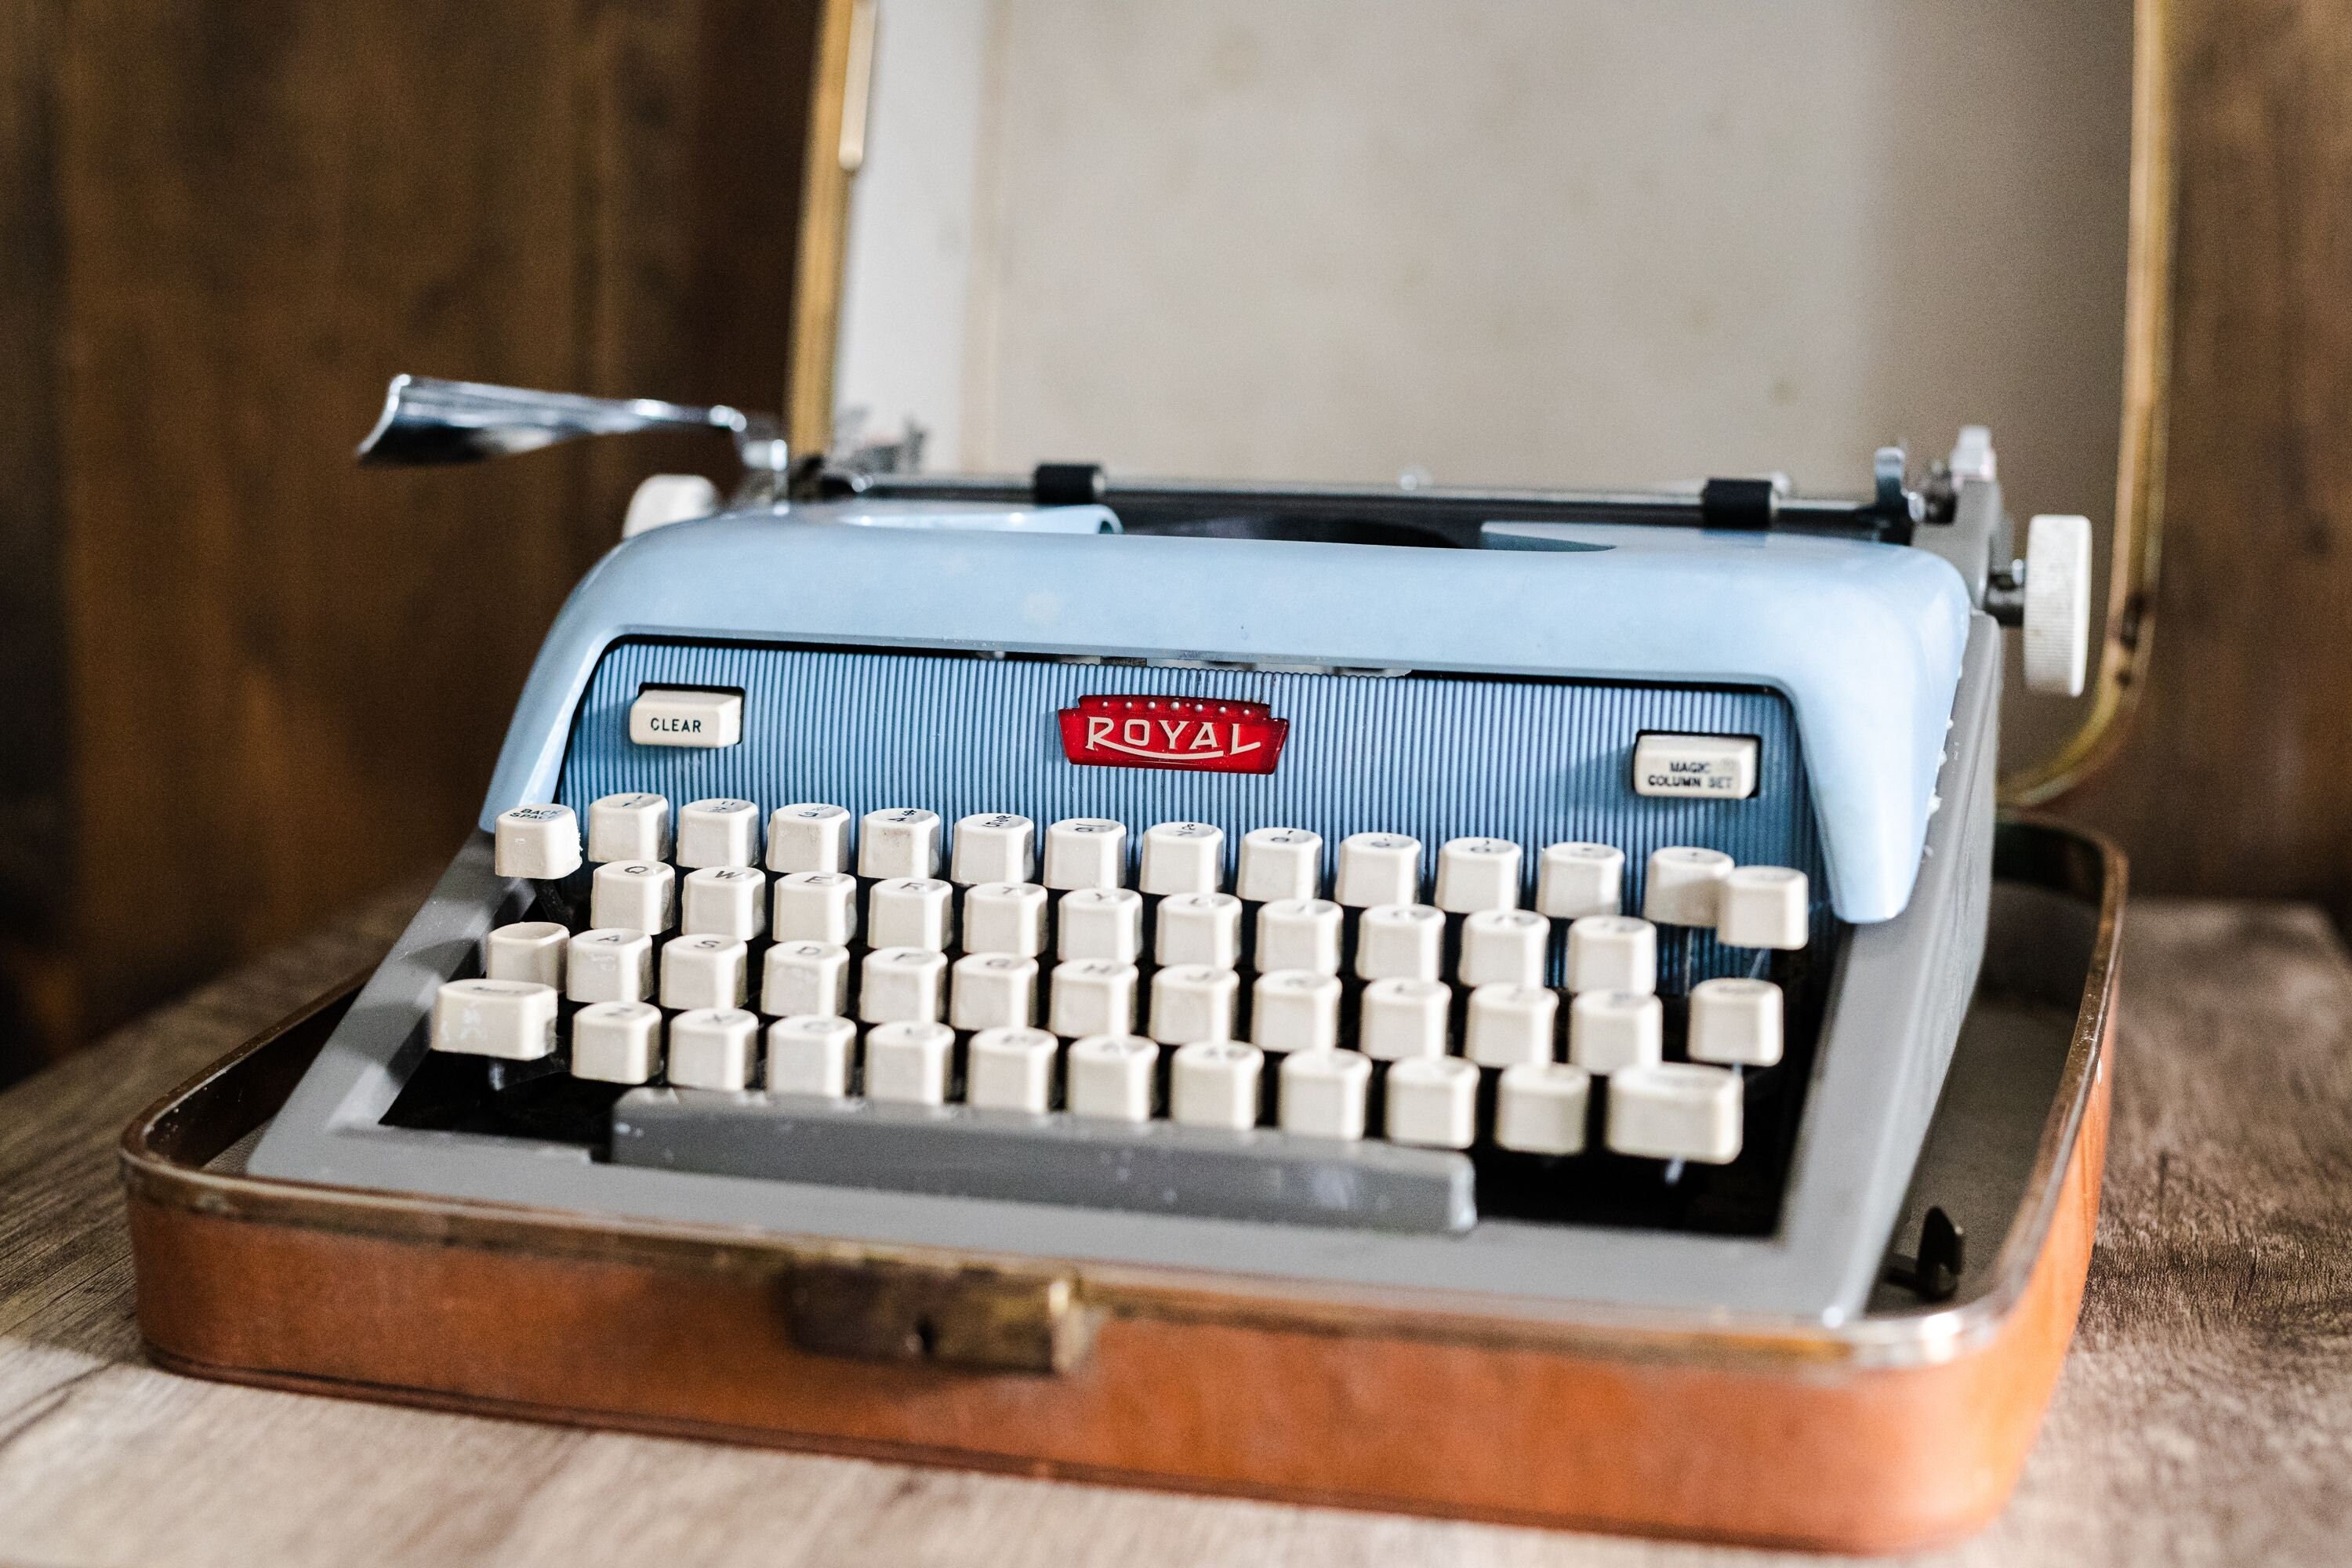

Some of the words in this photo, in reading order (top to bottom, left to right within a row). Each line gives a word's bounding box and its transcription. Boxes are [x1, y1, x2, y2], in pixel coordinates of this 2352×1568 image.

[650, 717, 702, 733] CLEAR
[1085, 716, 1261, 760] ROYAL
[1670, 762, 1711, 773] MAGIC
[1648, 775, 1701, 787] COLUMN
[1708, 776, 1733, 789] SET
